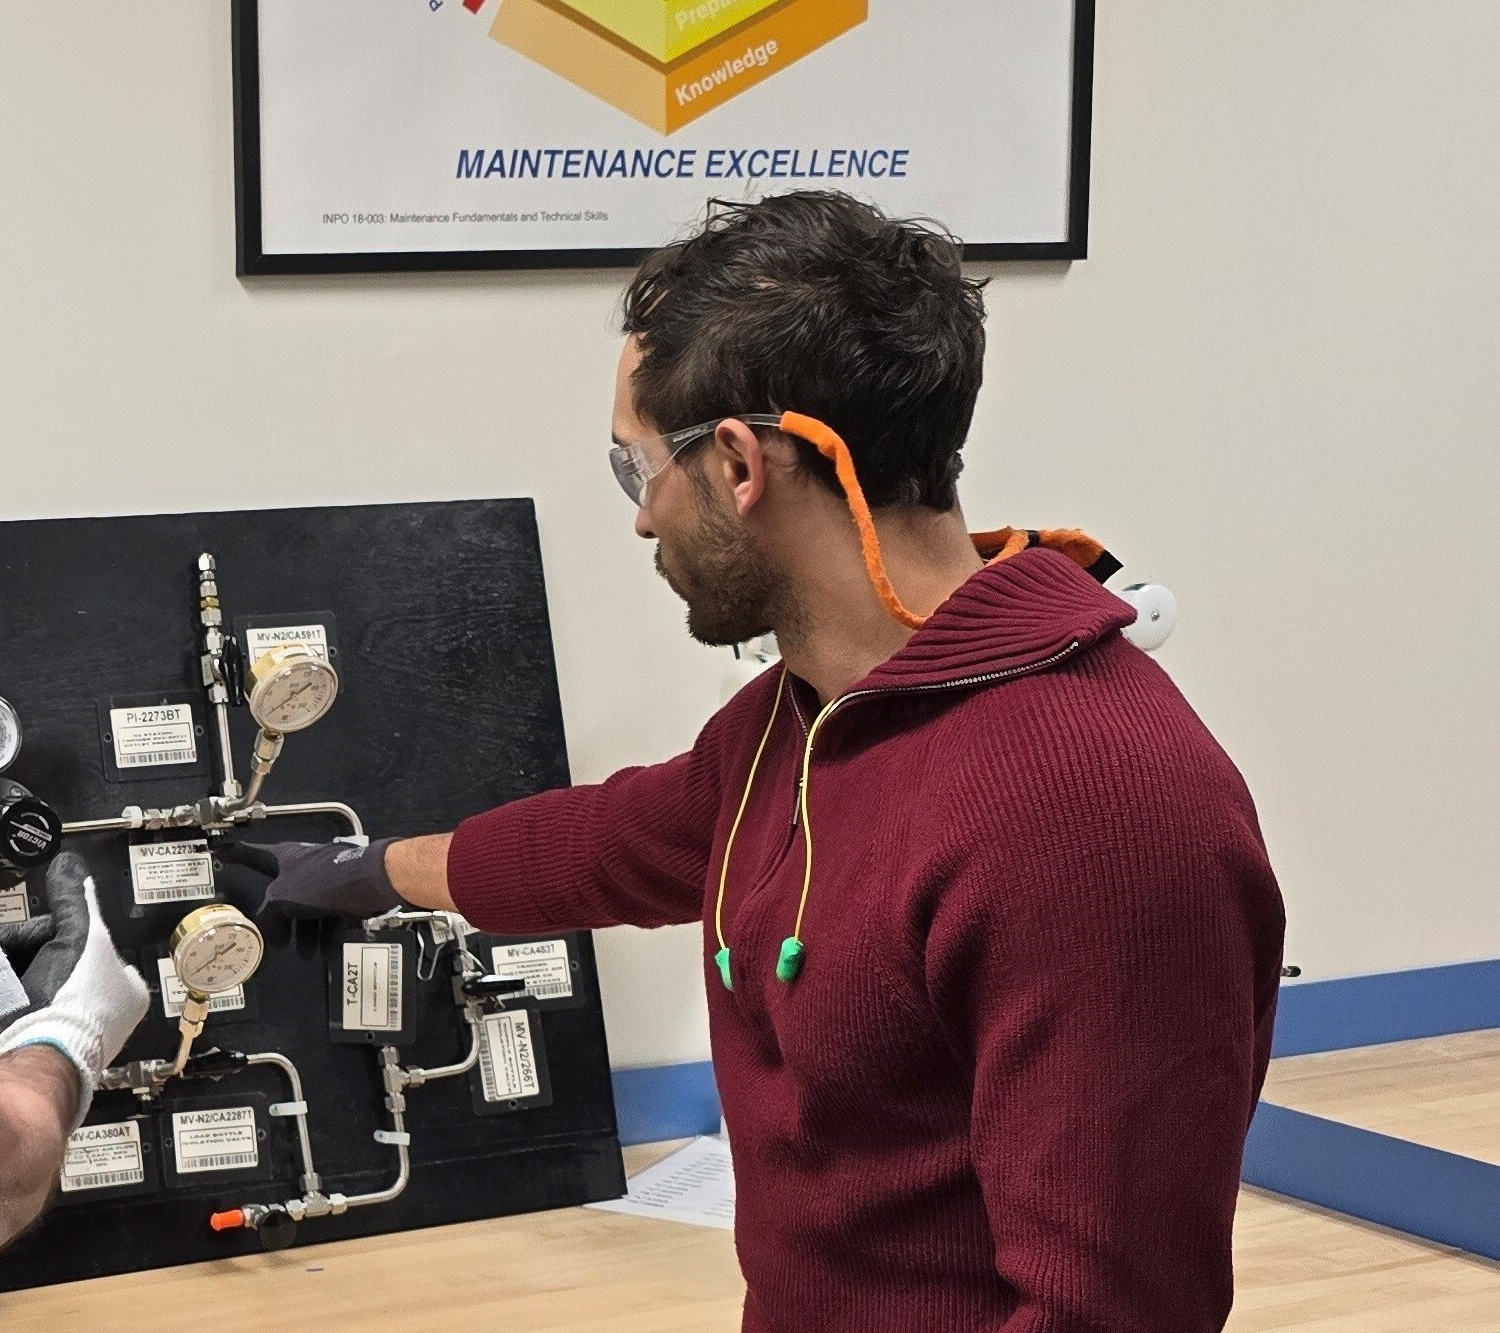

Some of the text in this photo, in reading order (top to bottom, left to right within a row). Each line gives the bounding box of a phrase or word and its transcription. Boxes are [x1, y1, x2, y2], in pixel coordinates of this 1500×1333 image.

[675, 0, 735, 31] Prepa
[674, 38, 779, 106] Knowledge
[456, 149, 910, 178] MAINTENANCE EXCELLENCE
[323, 210, 609, 224] INPO 18-003: Maintenance Fundamentals and Technical Skills
[127, 709, 180, 723] PI-2273BT
[17, 830, 47, 850] VICTOR
[140, 844, 198, 857] MV-CA2273
